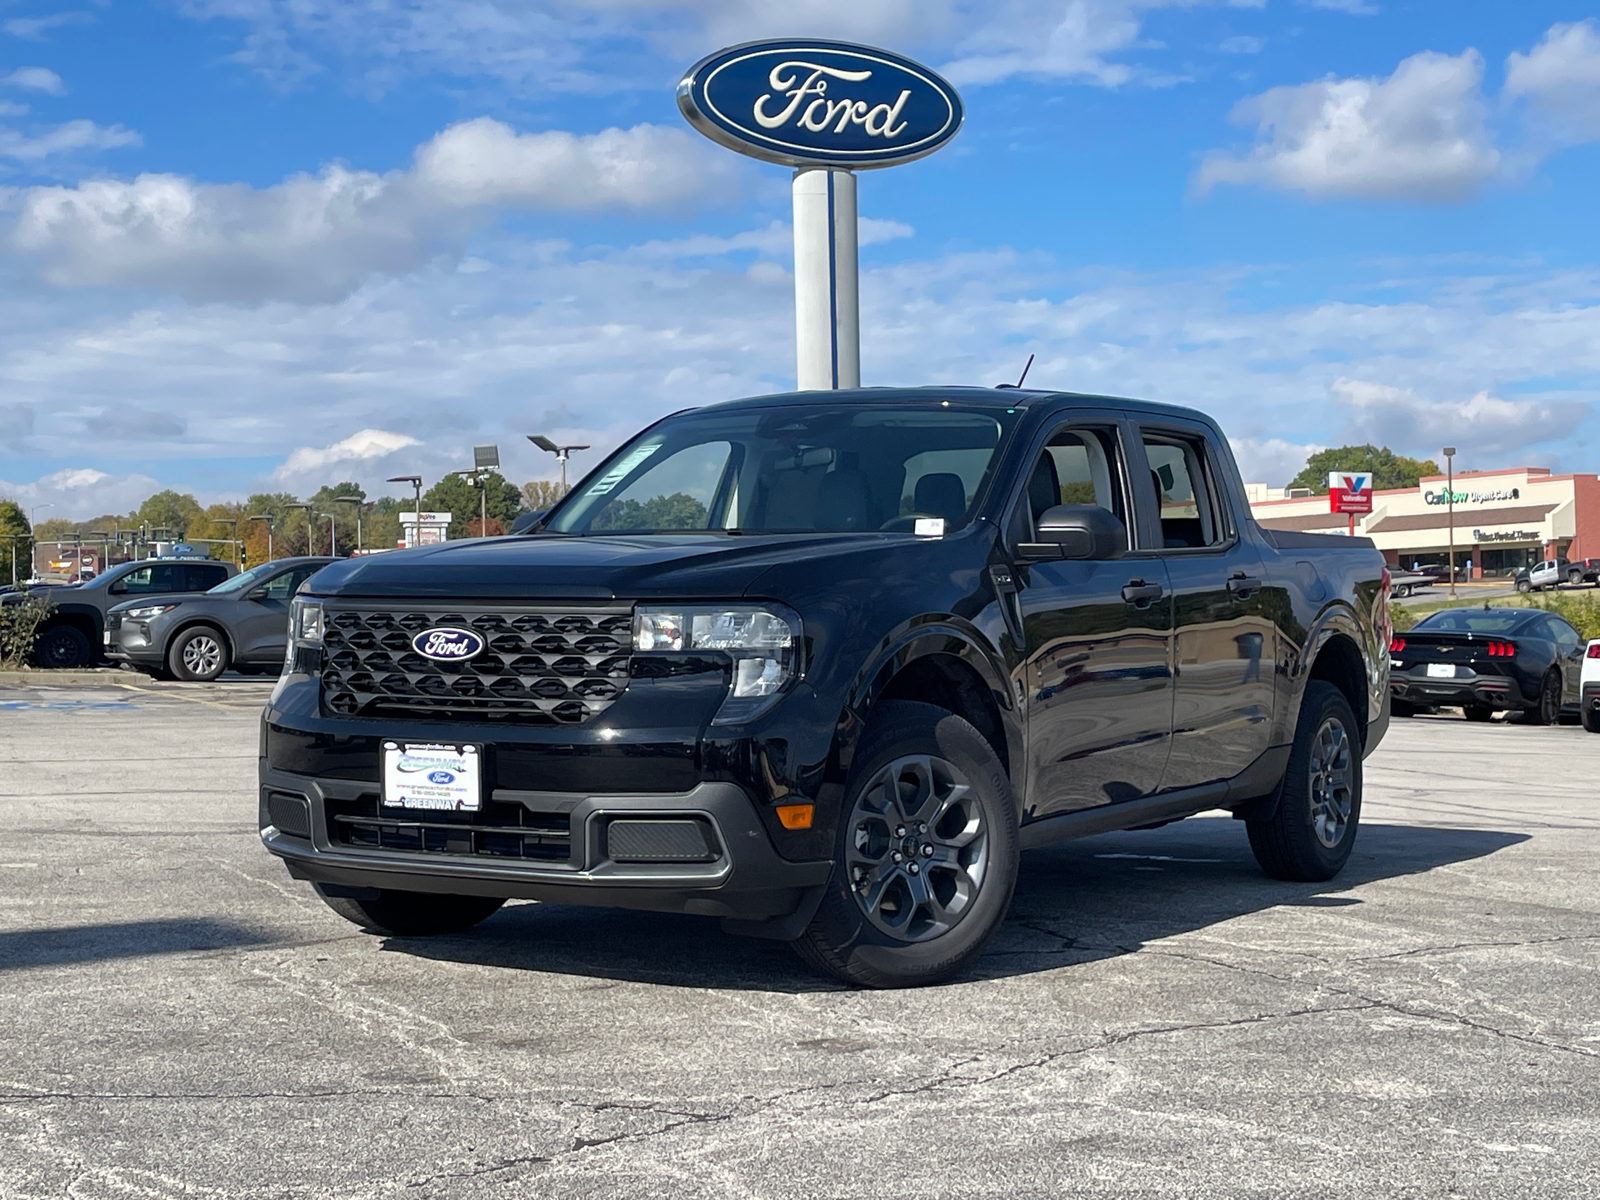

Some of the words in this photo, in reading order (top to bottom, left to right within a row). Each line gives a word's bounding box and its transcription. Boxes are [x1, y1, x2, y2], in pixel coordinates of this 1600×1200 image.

[753, 61, 911, 139] Ford
[425, 632, 469, 655] Ford
[404, 798, 457, 810] GREENWAY
